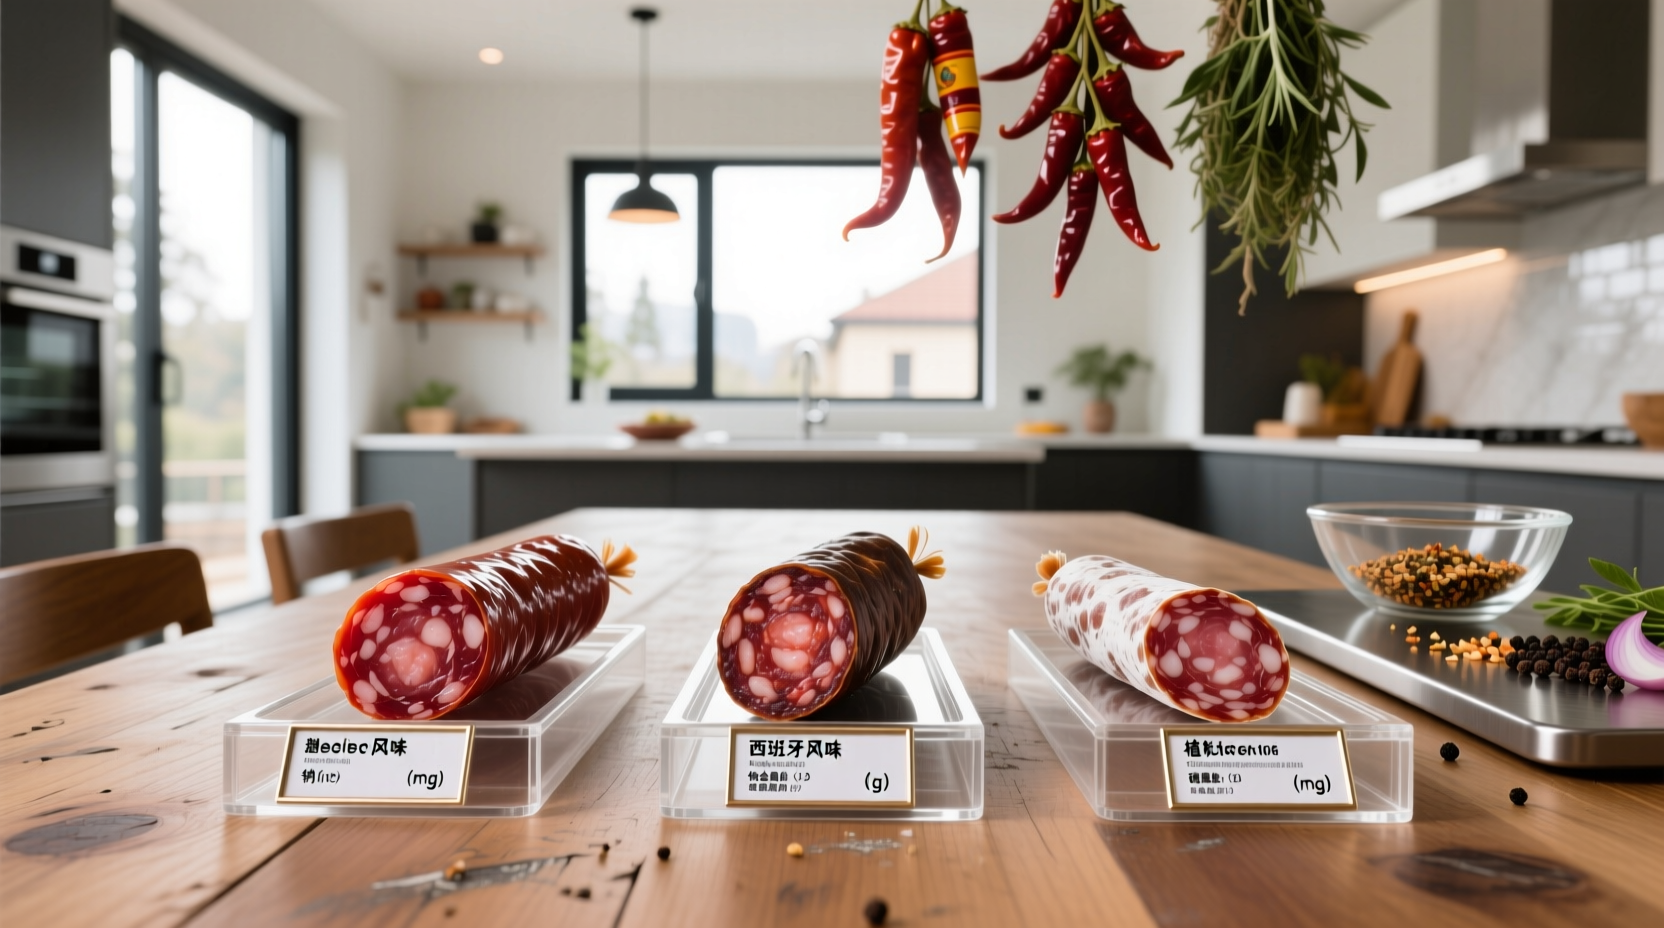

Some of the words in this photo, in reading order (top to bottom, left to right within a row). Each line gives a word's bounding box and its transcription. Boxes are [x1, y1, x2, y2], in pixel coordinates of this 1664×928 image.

[371, 738, 408, 756] 风味
[749, 739, 842, 759] 西班牙风味
[407, 769, 444, 790] (mg)
[865, 771, 889, 793] (g)
[1294, 774, 1331, 795] (mg)
